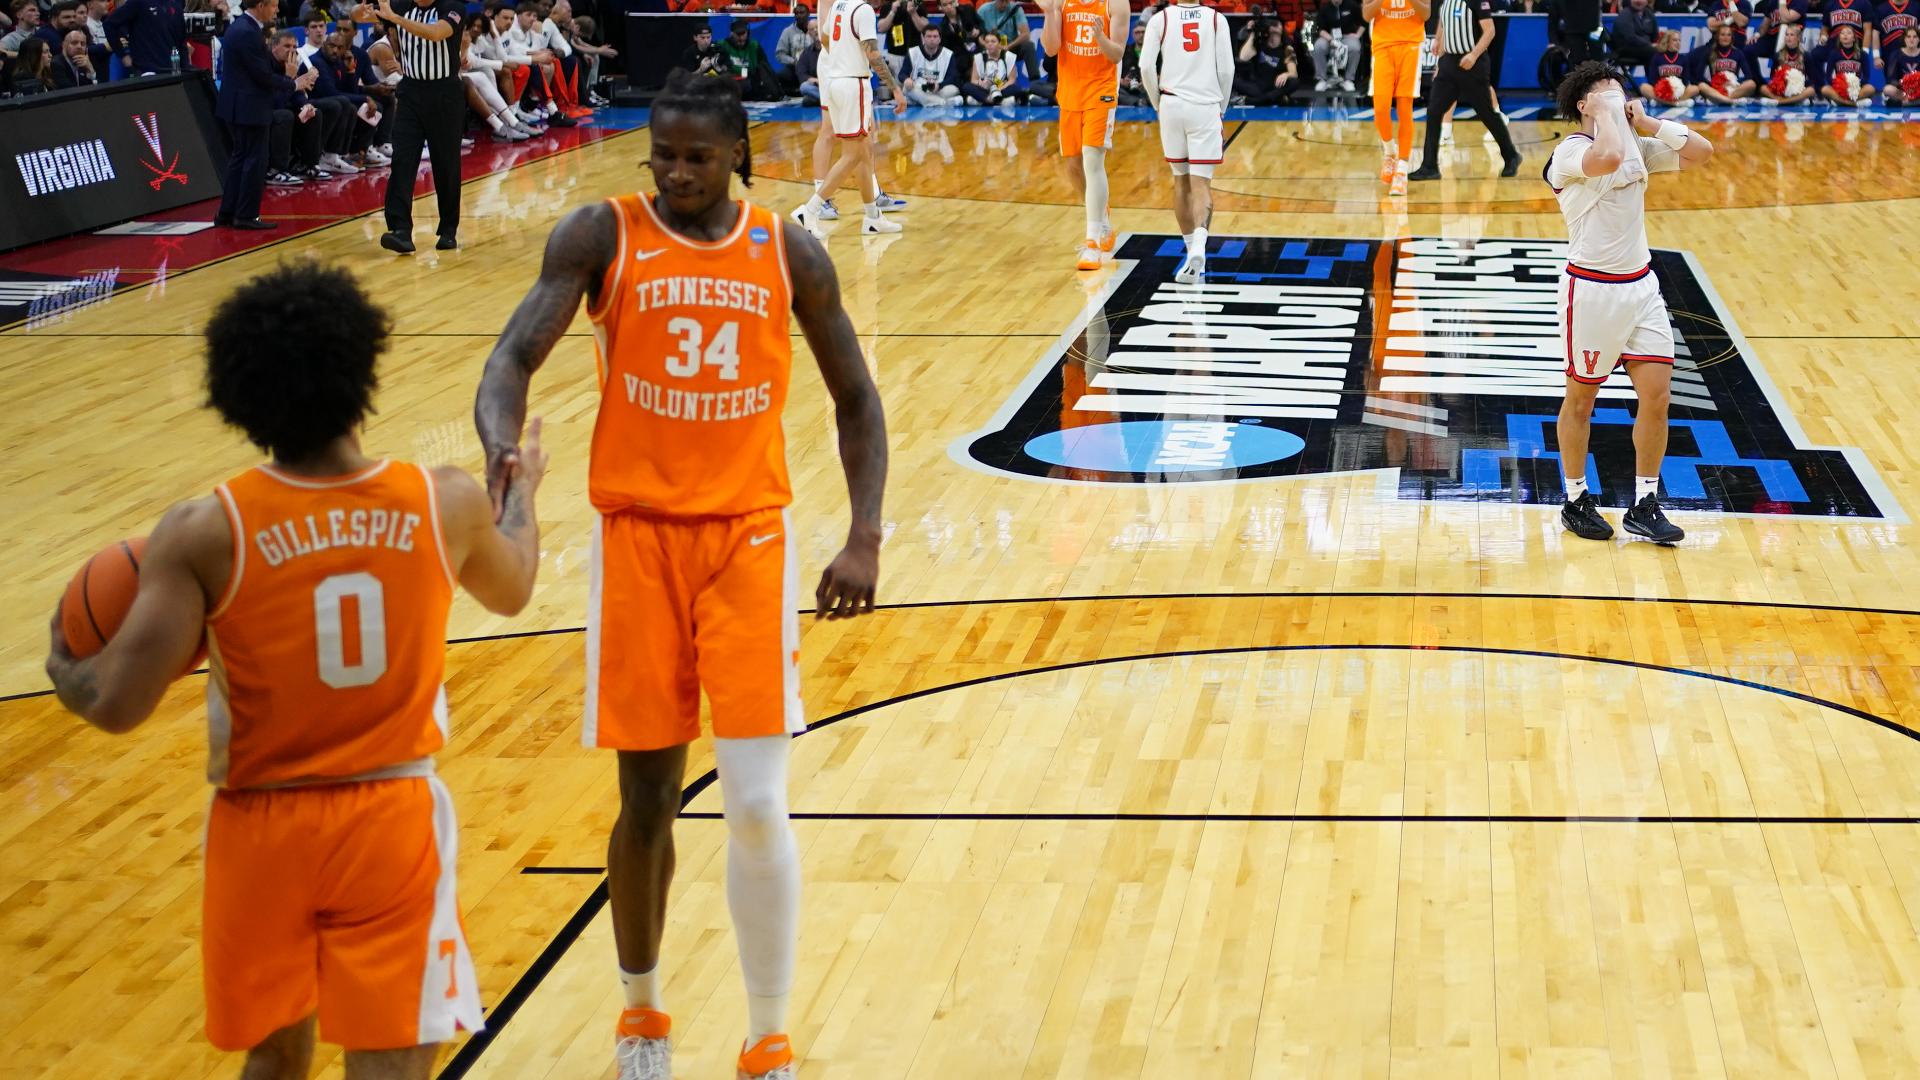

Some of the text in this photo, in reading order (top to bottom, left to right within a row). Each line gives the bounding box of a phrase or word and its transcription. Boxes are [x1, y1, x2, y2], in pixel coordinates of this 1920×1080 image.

[832, 14, 842, 41] 6
[1065, 11, 1104, 23] TENNESS
[1074, 24, 1095, 44] 13
[1180, 9, 1202, 21] LEWIS
[1182, 22, 1201, 52] 5
[15, 138, 116, 197] VIRGINIA
[636, 276, 771, 319] TENNESSEE
[664, 316, 740, 380] 34
[1072, 281, 1365, 420] MARCH
[1582, 349, 1601, 375] V
[623, 373, 771, 421] VOLUNTEERS
[1154, 422, 1239, 468] NCAA
[255, 507, 421, 567] GILLESPIE
[313, 571, 388, 690] 0
